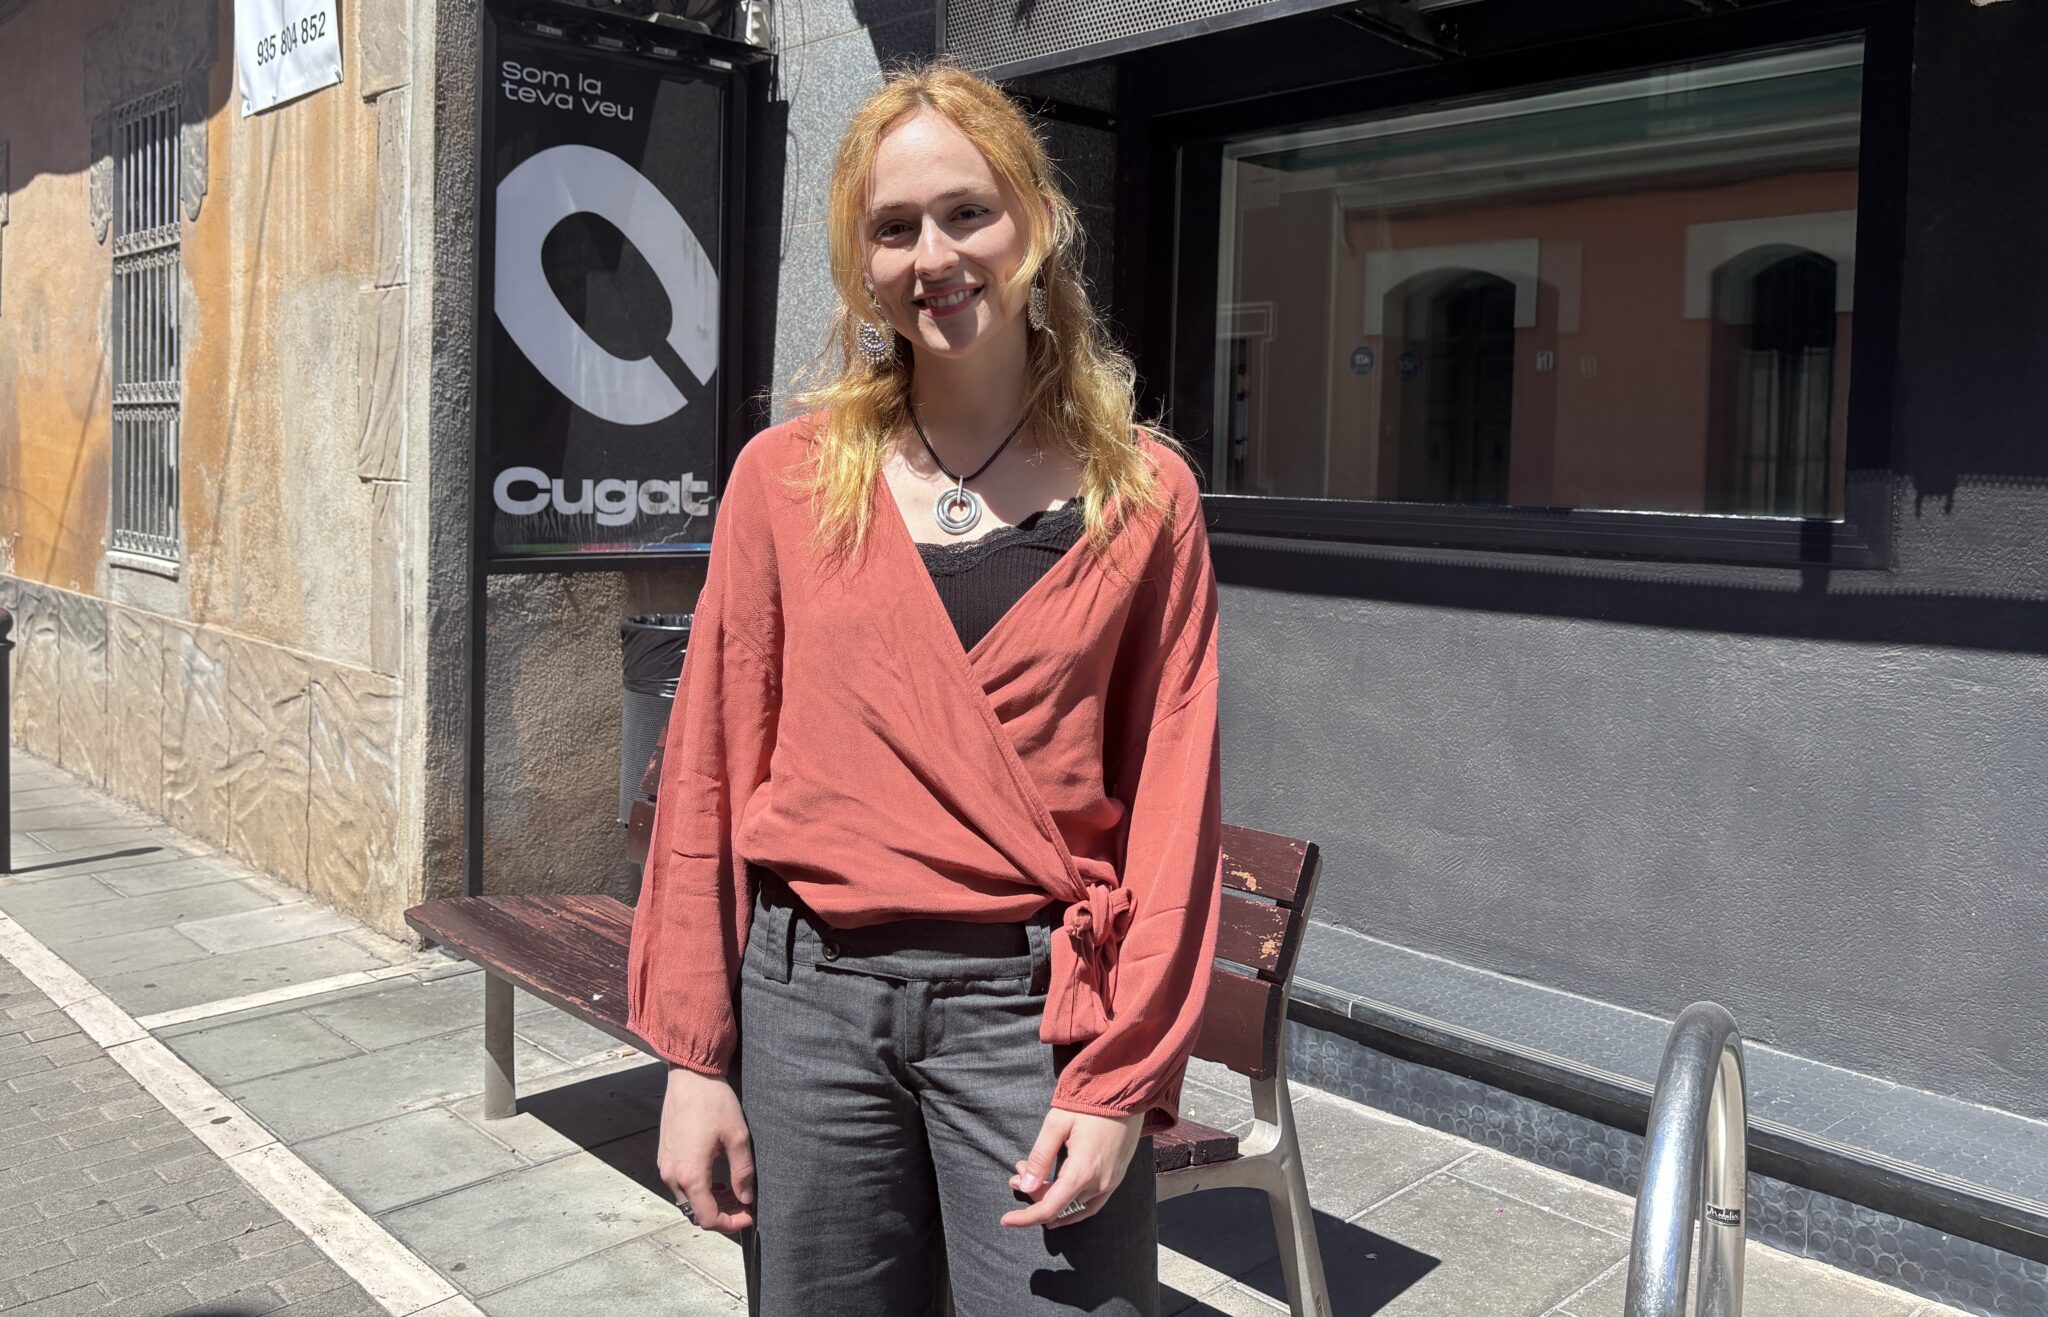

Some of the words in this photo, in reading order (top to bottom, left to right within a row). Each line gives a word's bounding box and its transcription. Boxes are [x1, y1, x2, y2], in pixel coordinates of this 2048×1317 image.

[257, 34, 277, 66] 935
[280, 22, 298, 57] 804
[301, 11, 326, 45] 852
[501, 80, 574, 110] teva
[581, 97, 634, 122] veu
[502, 60, 570, 90] Som
[578, 72, 602, 96] la
[493, 466, 709, 527] Cugat
